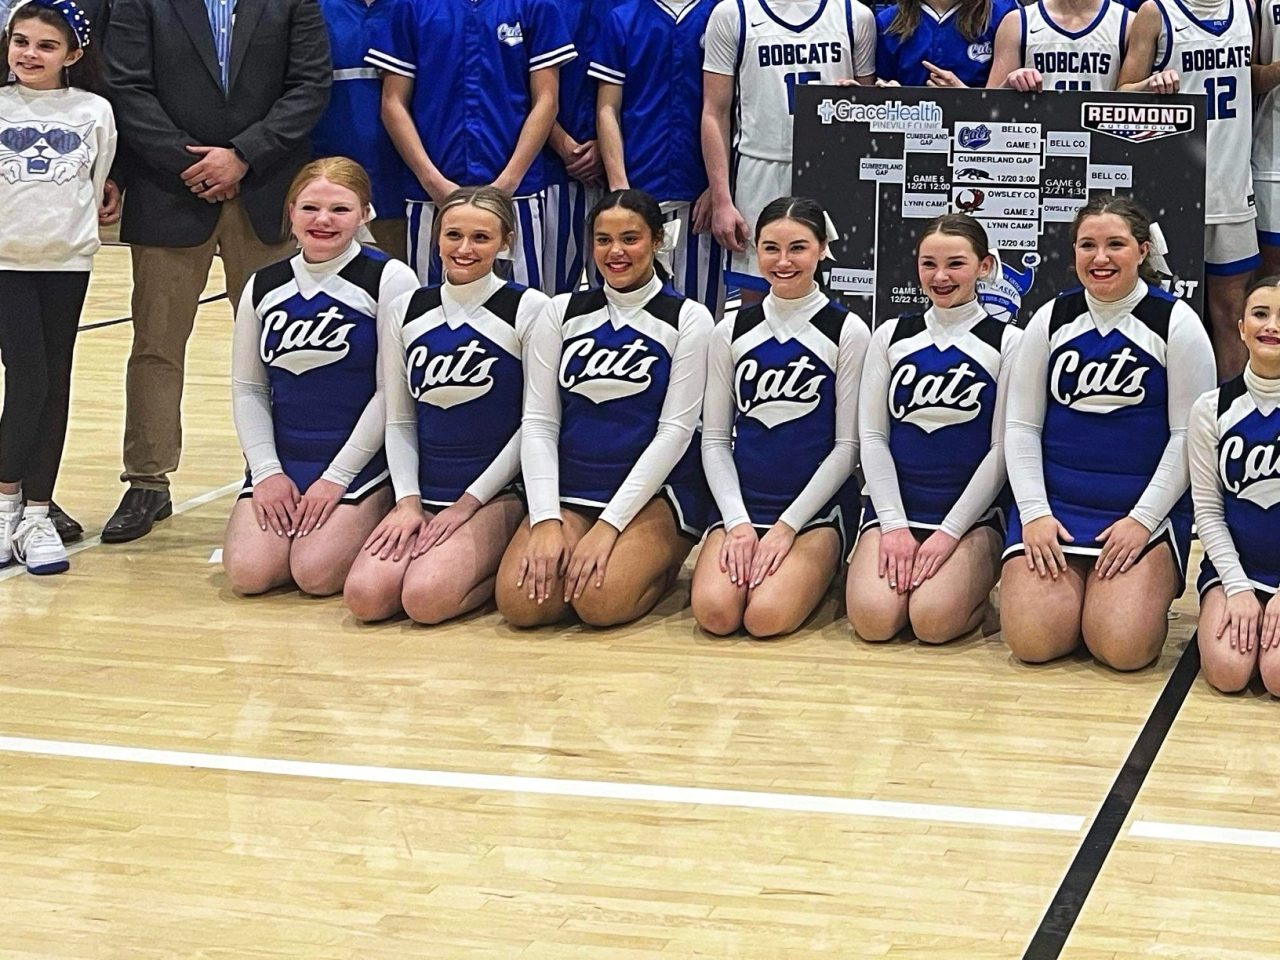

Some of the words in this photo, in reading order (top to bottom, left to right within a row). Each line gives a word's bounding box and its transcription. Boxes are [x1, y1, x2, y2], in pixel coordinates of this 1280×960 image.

[758, 42, 841, 67] BOBCATS
[1034, 52, 1111, 74] BOBCATS
[1181, 45, 1251, 73] BOBCATS
[1204, 76, 1237, 120] 12
[836, 101, 941, 121] GraceHealth
[1088, 107, 1188, 123] REDMOND
[1073, 140, 1088, 148] CO.
[958, 156, 1015, 164] CUMBERLAND
[997, 175, 1017, 183] 12/20
[1092, 172, 1112, 180] BELL
[1040, 187, 1065, 195] 12/21
[1067, 187, 1086, 195] 4:30
[831, 275, 874, 285] BELLEVUE
[890, 296, 911, 304] 12/22
[892, 287, 916, 295] GAME
[260, 306, 357, 368] Cats
[407, 342, 498, 404] Cats
[559, 335, 659, 398] Cats
[735, 356, 827, 421] Cats
[1051, 348, 1150, 410] Cats
[888, 361, 987, 428] Cats
